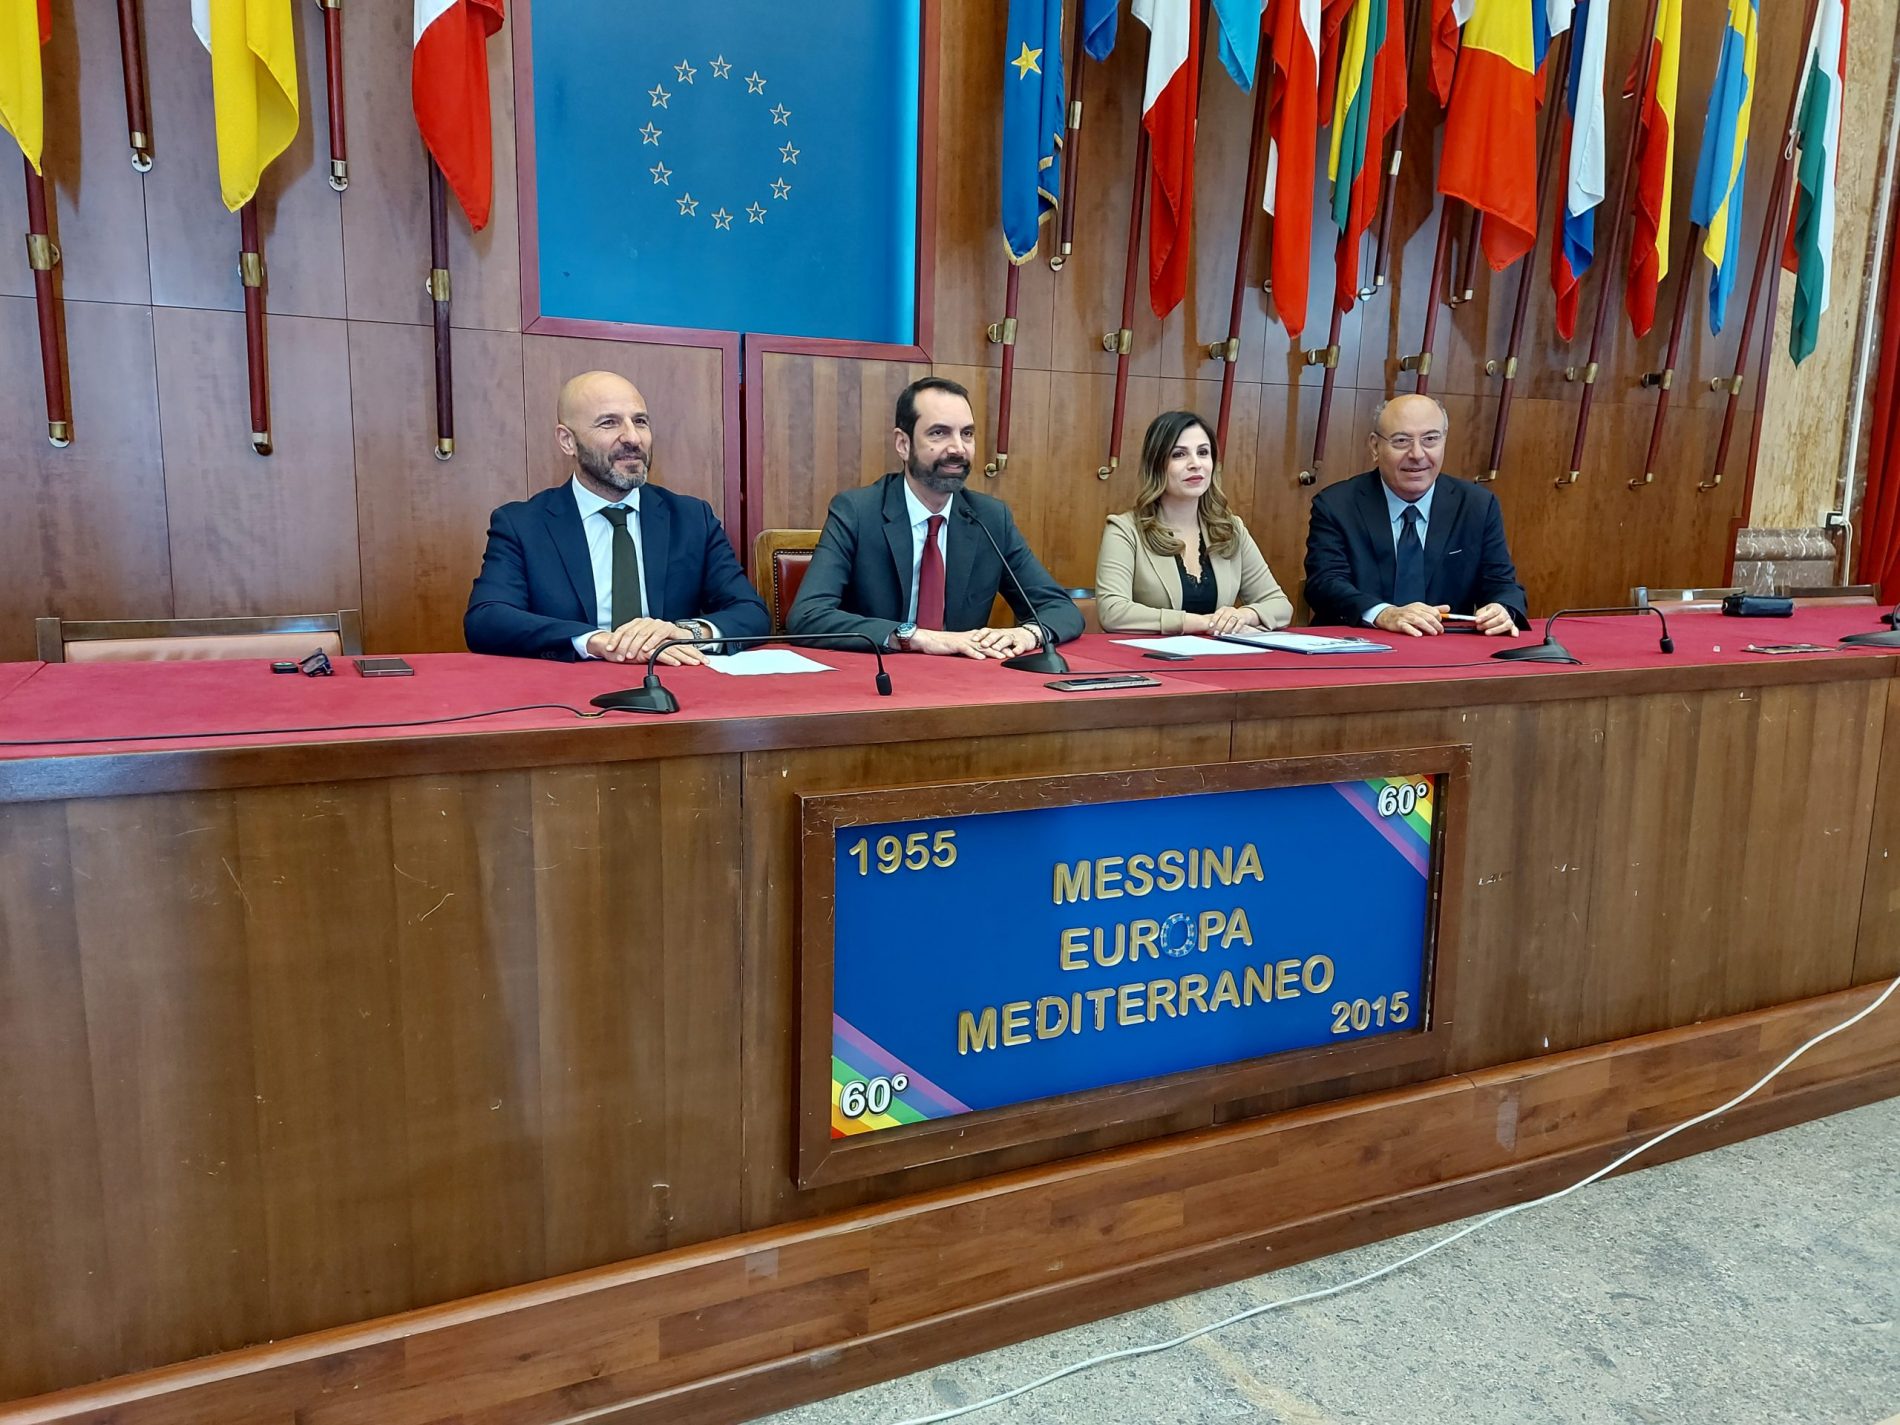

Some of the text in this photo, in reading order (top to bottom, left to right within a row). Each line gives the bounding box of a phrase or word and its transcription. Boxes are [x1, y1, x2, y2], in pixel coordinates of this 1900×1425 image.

[1377, 781, 1429, 818] 60°
[848, 830, 958, 876] 1955
[1053, 843, 1265, 905] MESSINA
[1060, 908, 1253, 971] EUROPA
[957, 954, 1335, 1055] MEDITERRANEO
[1331, 991, 1410, 1034] 2015
[839, 1072, 910, 1118] 60°
